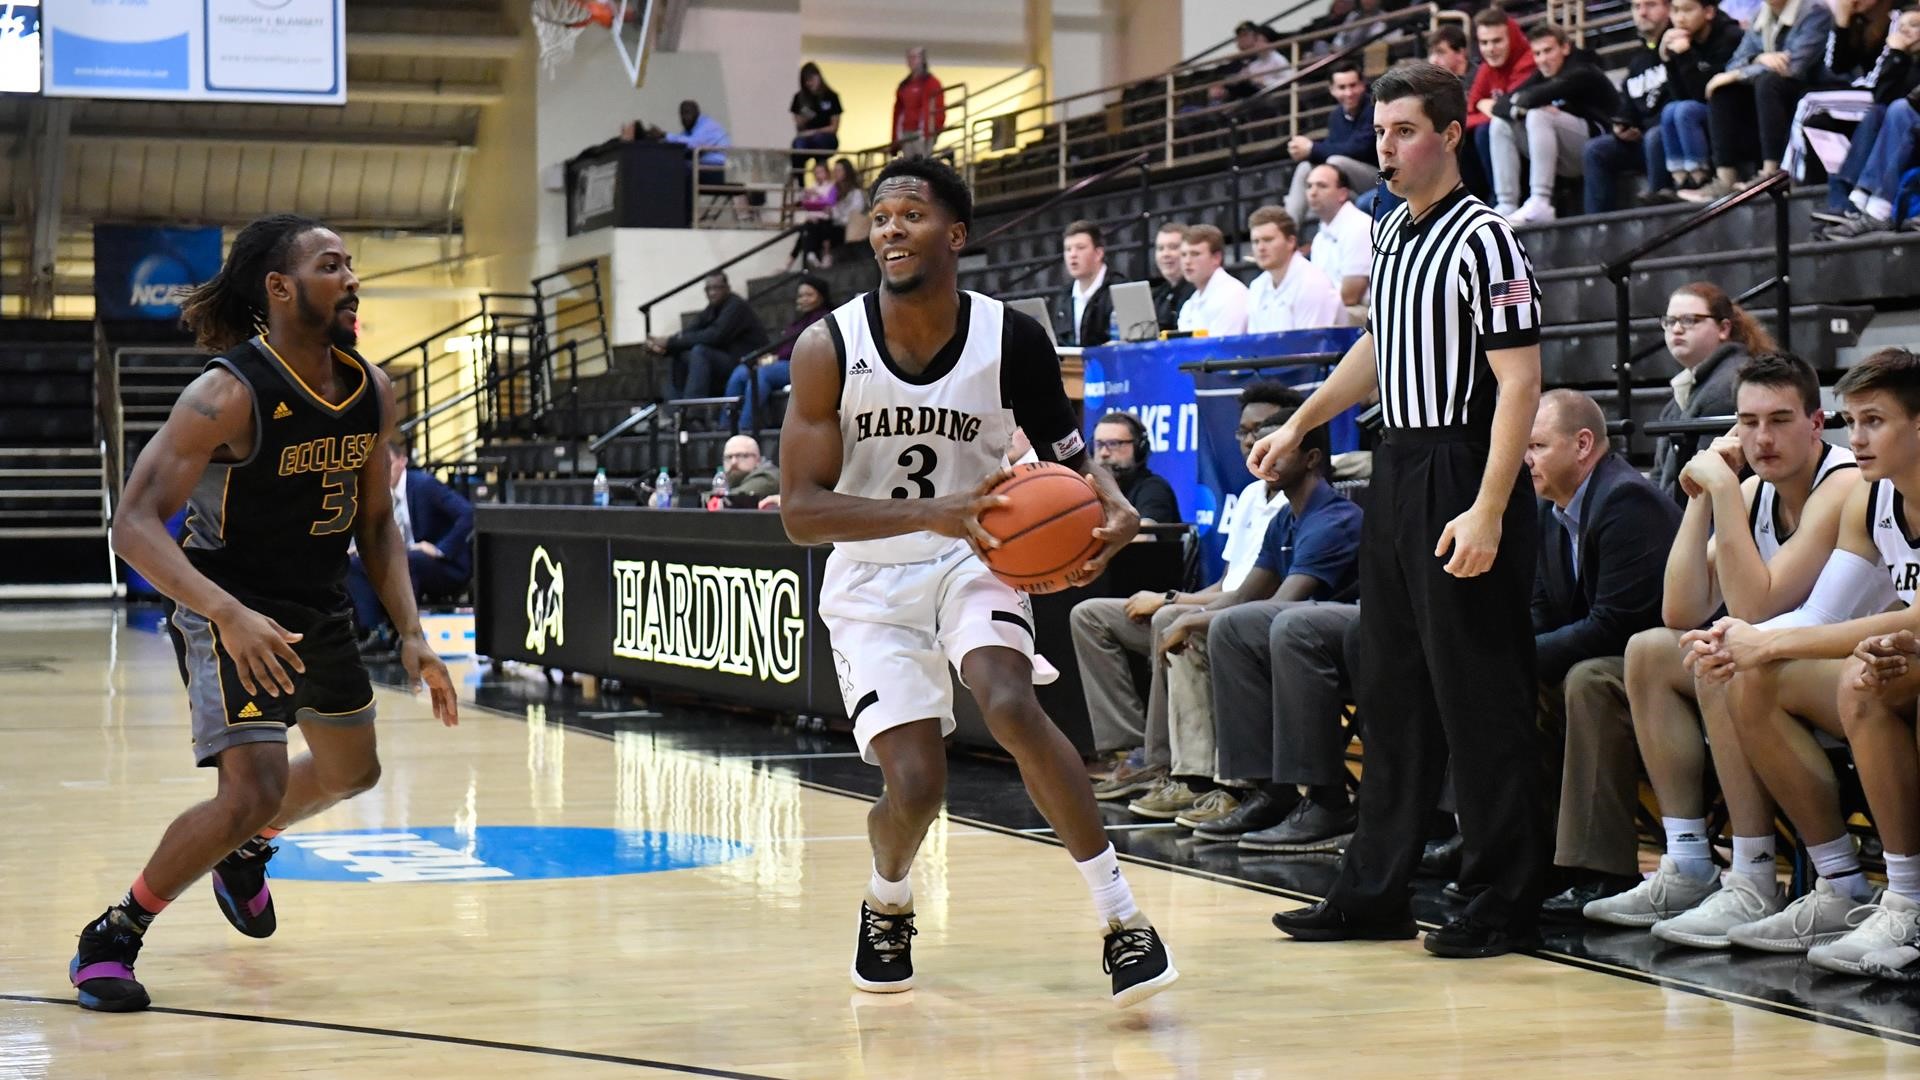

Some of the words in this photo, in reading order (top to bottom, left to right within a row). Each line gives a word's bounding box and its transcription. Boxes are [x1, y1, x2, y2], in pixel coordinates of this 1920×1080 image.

[849, 367, 873, 376] adidas
[855, 406, 982, 442] HARDING
[891, 443, 938, 500] 3
[309, 468, 359, 536] 3
[613, 560, 804, 684] HARDING
